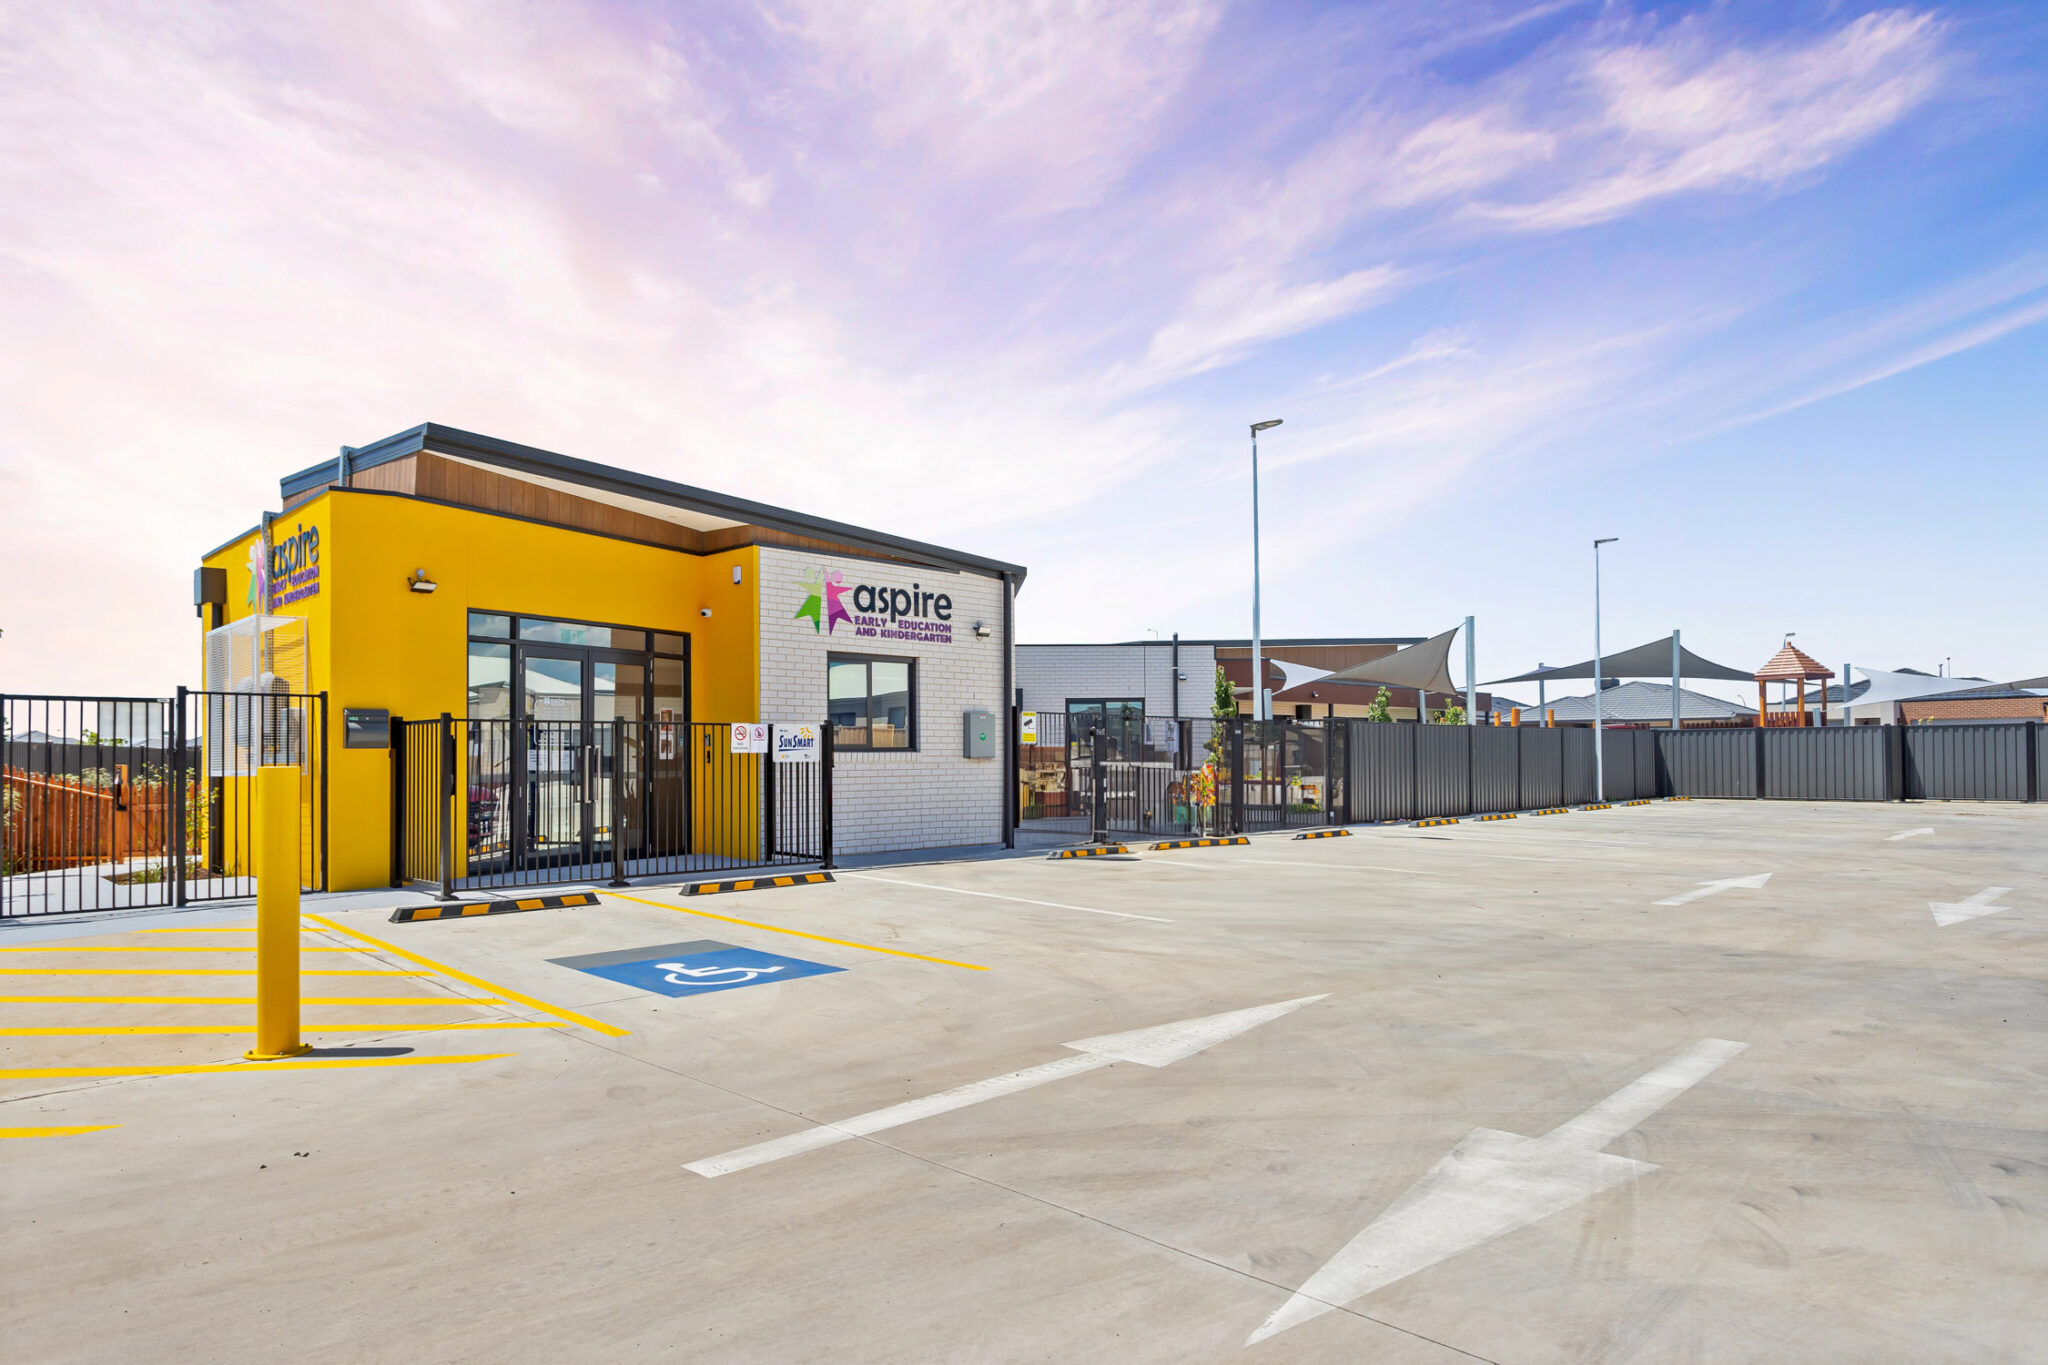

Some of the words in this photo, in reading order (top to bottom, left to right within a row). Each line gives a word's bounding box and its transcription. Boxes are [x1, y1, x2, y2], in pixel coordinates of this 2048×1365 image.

[272, 523, 319, 583] aspire
[853, 583, 952, 623] aspire
[854, 615, 887, 627] EARLY
[898, 619, 952, 633] EDUCATION
[855, 627, 877, 637] AND
[880, 629, 952, 644] KINDERGARTEN
